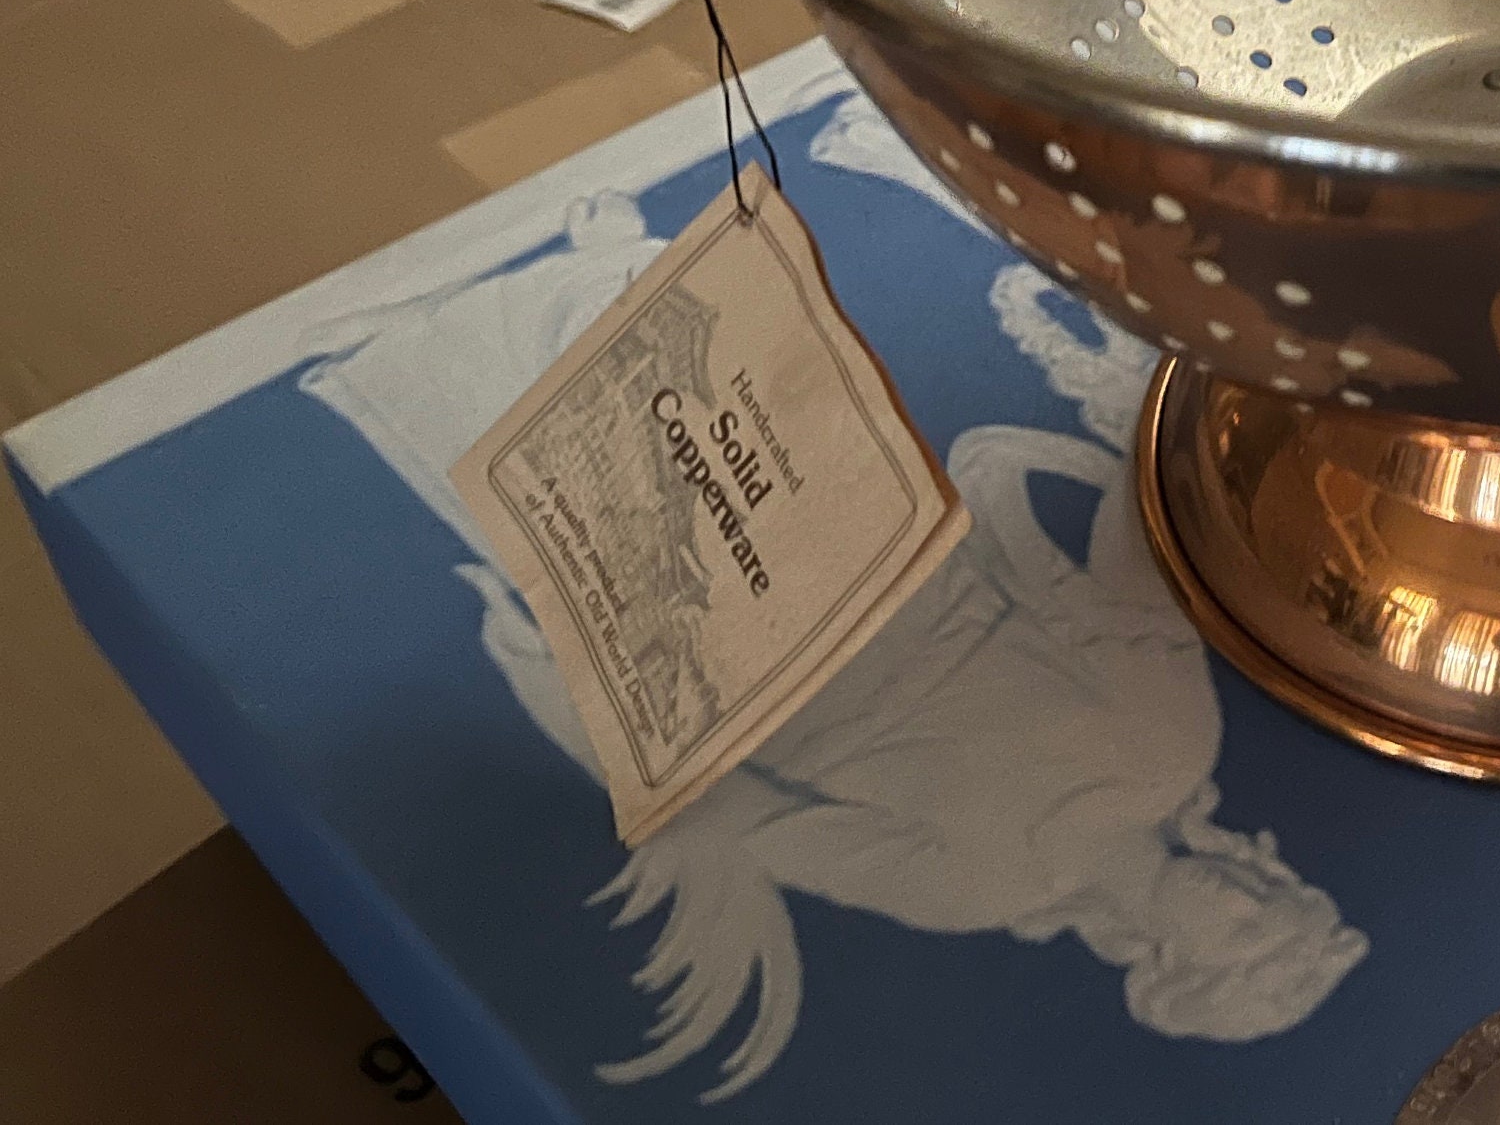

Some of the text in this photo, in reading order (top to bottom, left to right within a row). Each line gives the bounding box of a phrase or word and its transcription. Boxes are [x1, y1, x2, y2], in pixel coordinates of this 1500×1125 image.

[650, 387, 770, 599] Copperware
[709, 409, 774, 512] Solid
[731, 368, 806, 496] Handcrafted
[540, 476, 629, 615] A quality product
[524, 493, 656, 739] of Authentic Old World Design
